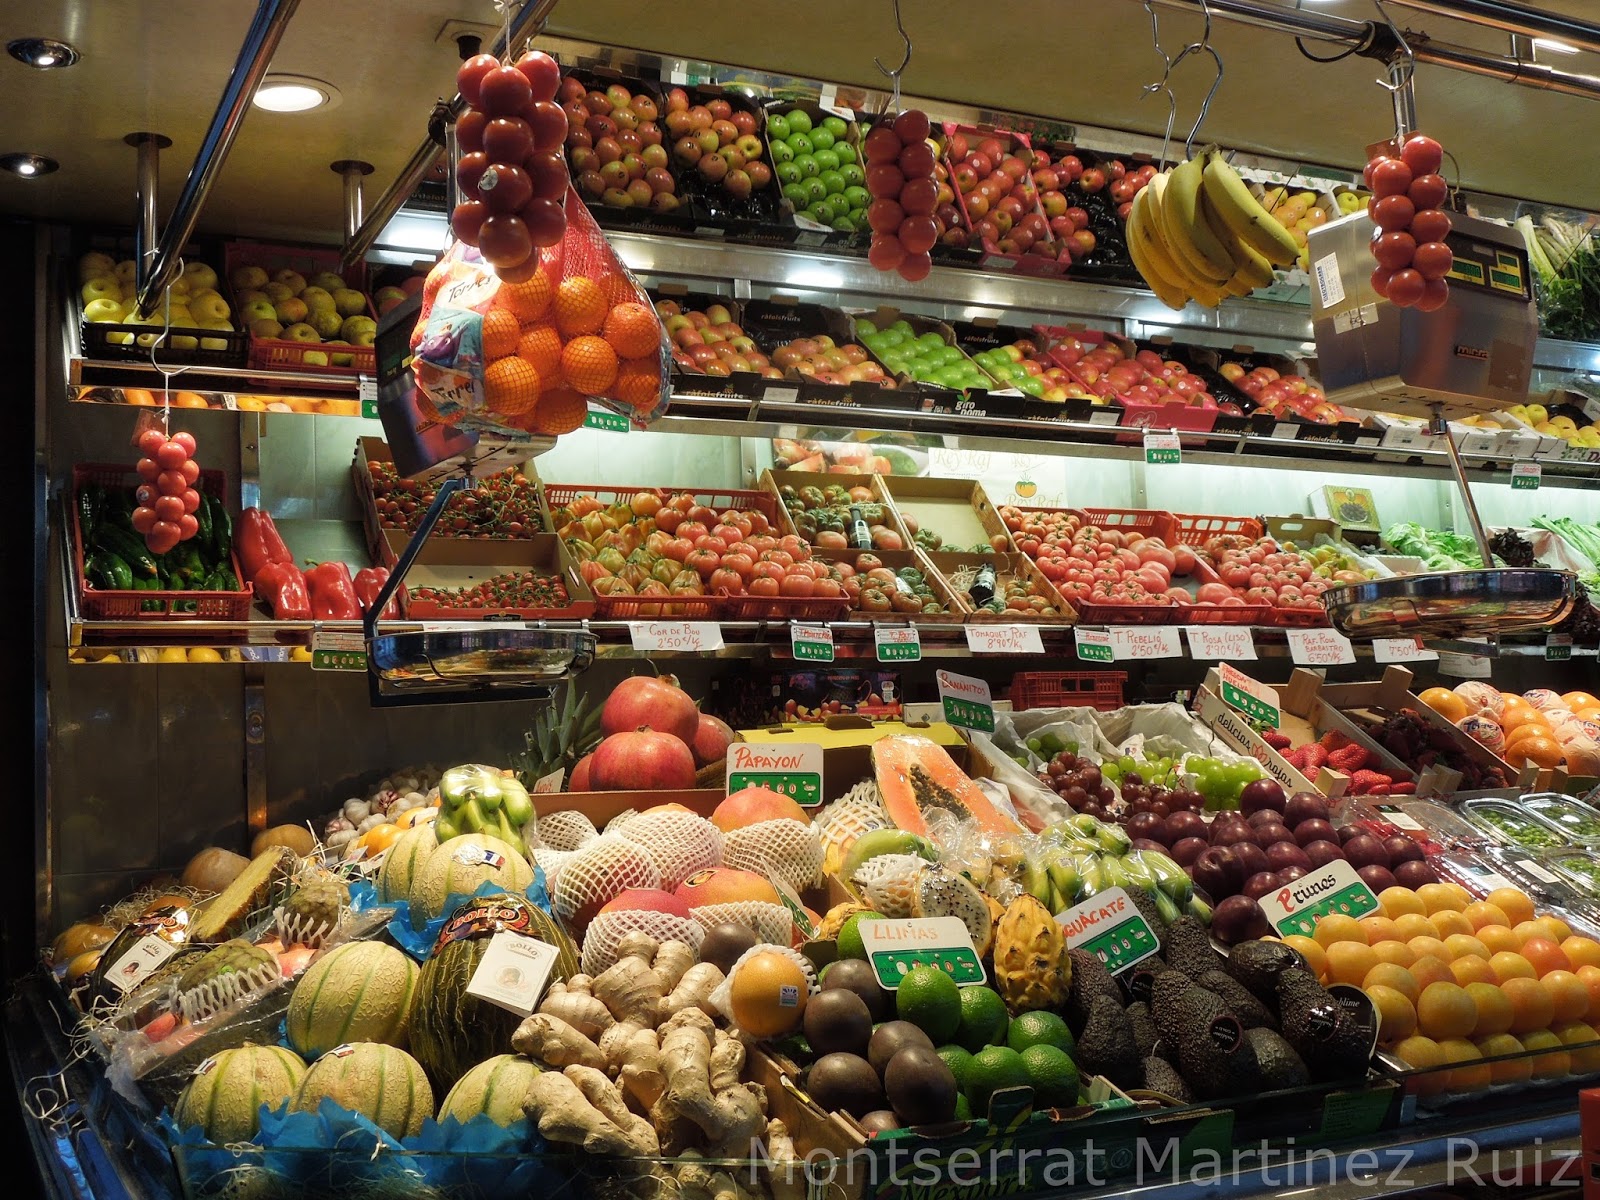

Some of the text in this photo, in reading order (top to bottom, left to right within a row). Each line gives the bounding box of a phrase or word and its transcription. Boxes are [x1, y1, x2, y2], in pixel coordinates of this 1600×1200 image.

[448, 275, 496, 302] Torres
[955, 400, 976, 411] giro
[941, 672, 986, 696] BANANITOS
[735, 746, 804, 769] PAPAYON
[1217, 712, 1293, 788] delicias rojas
[1276, 874, 1337, 913] Prunes
[452, 907, 517, 930] BOLLO
[873, 923, 939, 940] LLIMAS
[509, 941, 539, 956] BOLLO
